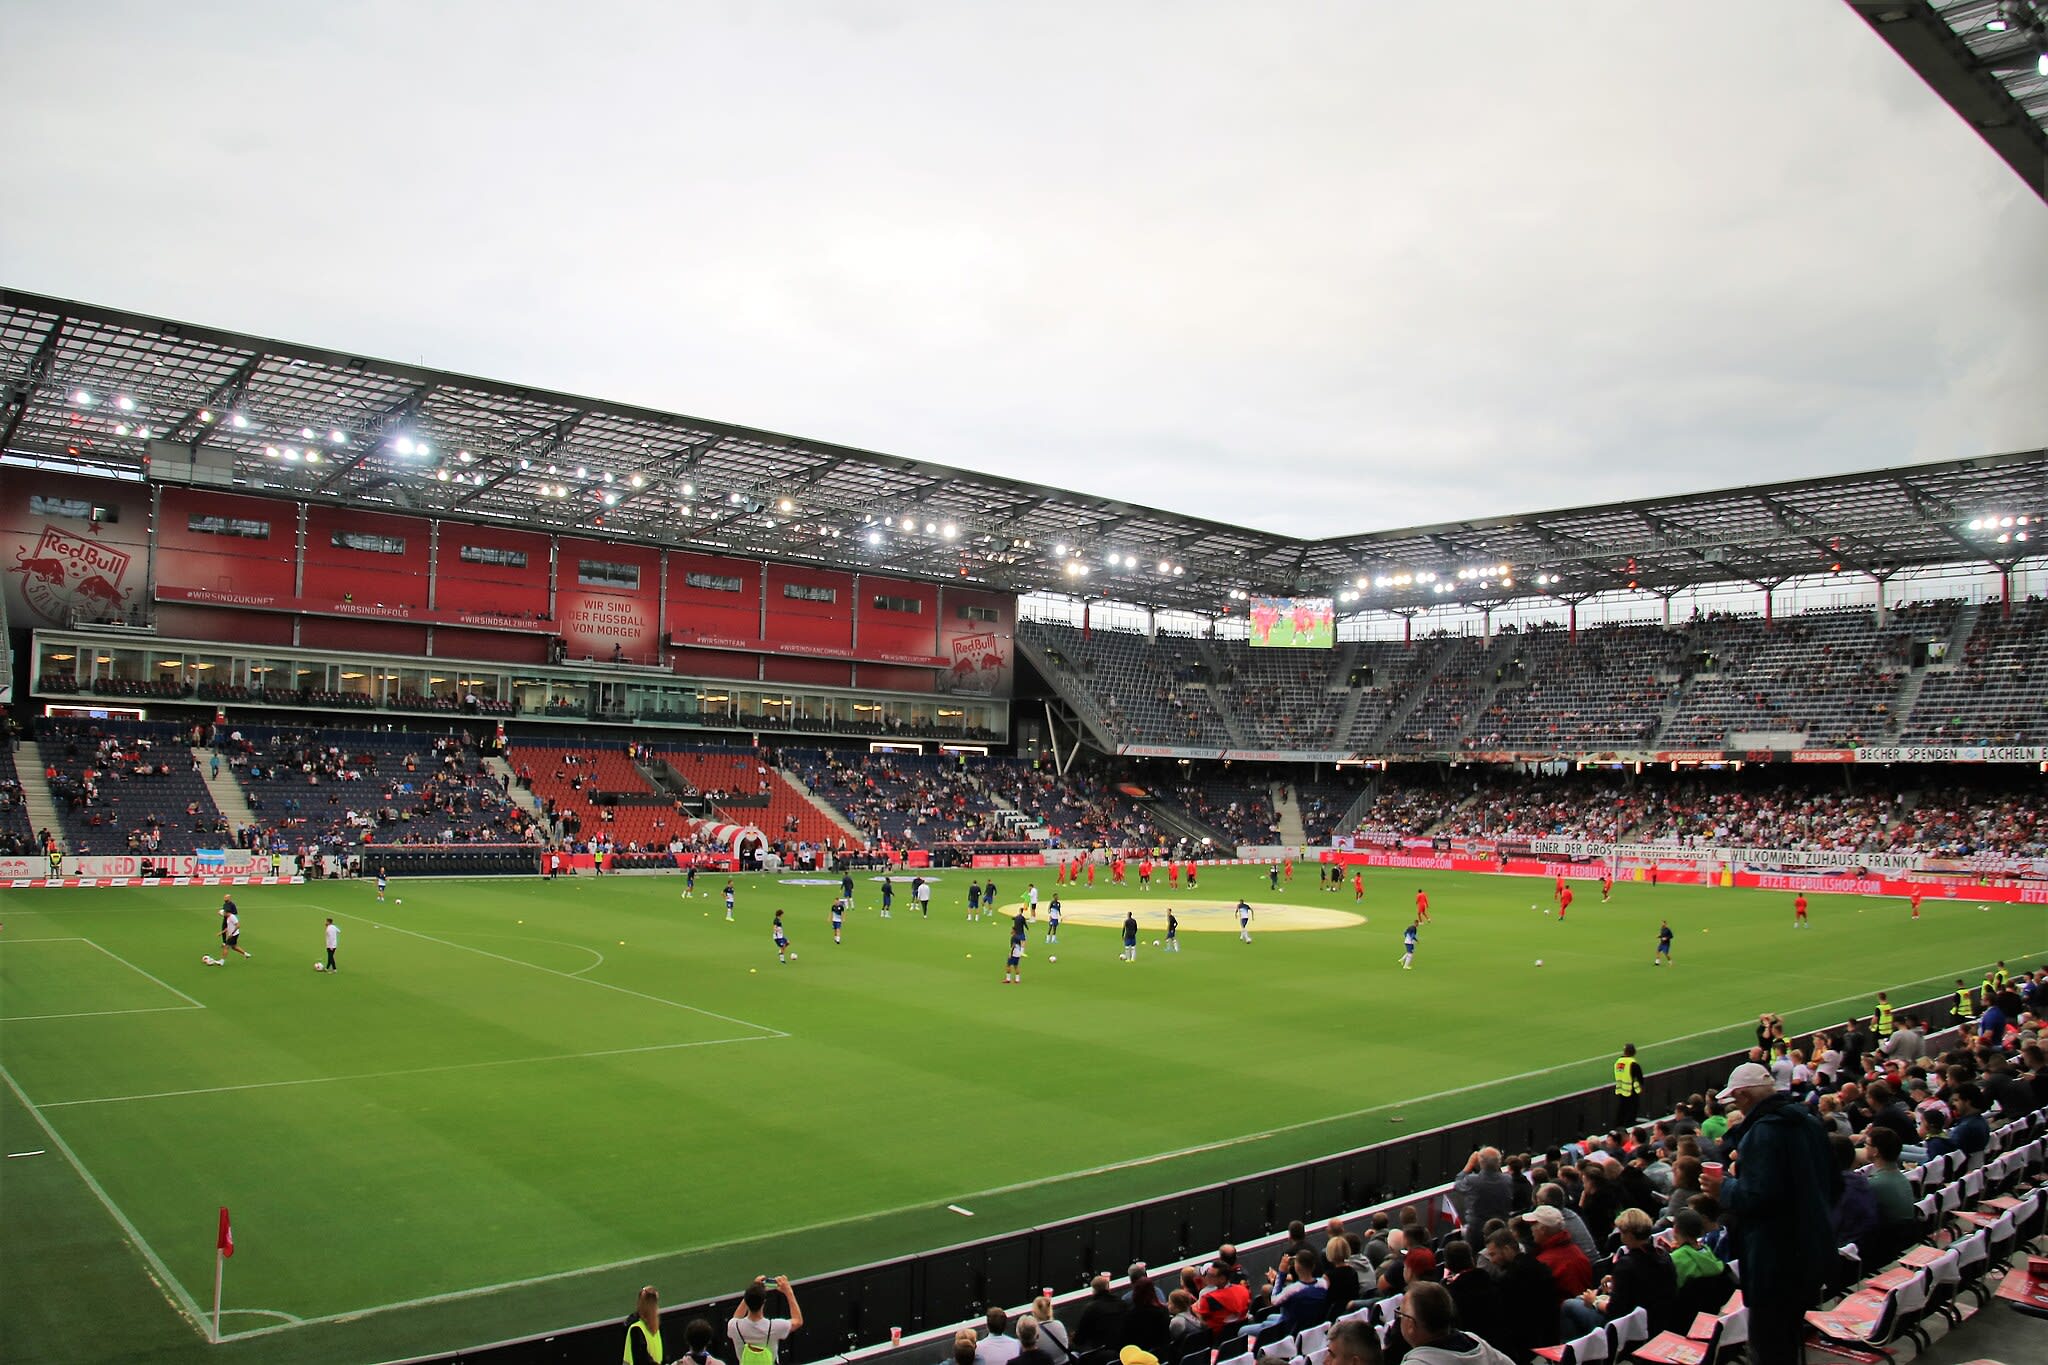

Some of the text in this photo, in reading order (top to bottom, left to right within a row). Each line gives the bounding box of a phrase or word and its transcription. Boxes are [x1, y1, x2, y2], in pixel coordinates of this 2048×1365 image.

[45, 533, 123, 574] Red Bull
[584, 600, 632, 614] WIR SIND
[568, 610, 646, 627] DER FUSSBALL
[572, 623, 641, 639] VON MORGEN
[955, 635, 993, 655] Red Bull
[1860, 749, 1899, 760] BECHER
[1908, 749, 1957, 760] SPENDEN
[1368, 855, 1453, 870] JETZT: REDBULLSHOP.COM
[1535, 842, 1559, 853] EINER
[1565, 843, 1582, 854] DER
[1730, 849, 1799, 863] WILLKOMMEN
[1806, 853, 1860, 867] ZUHAUSE
[1758, 875, 1787, 888] JETZT:
[1788, 877, 1881, 893] REDBULLSHOP.COM
